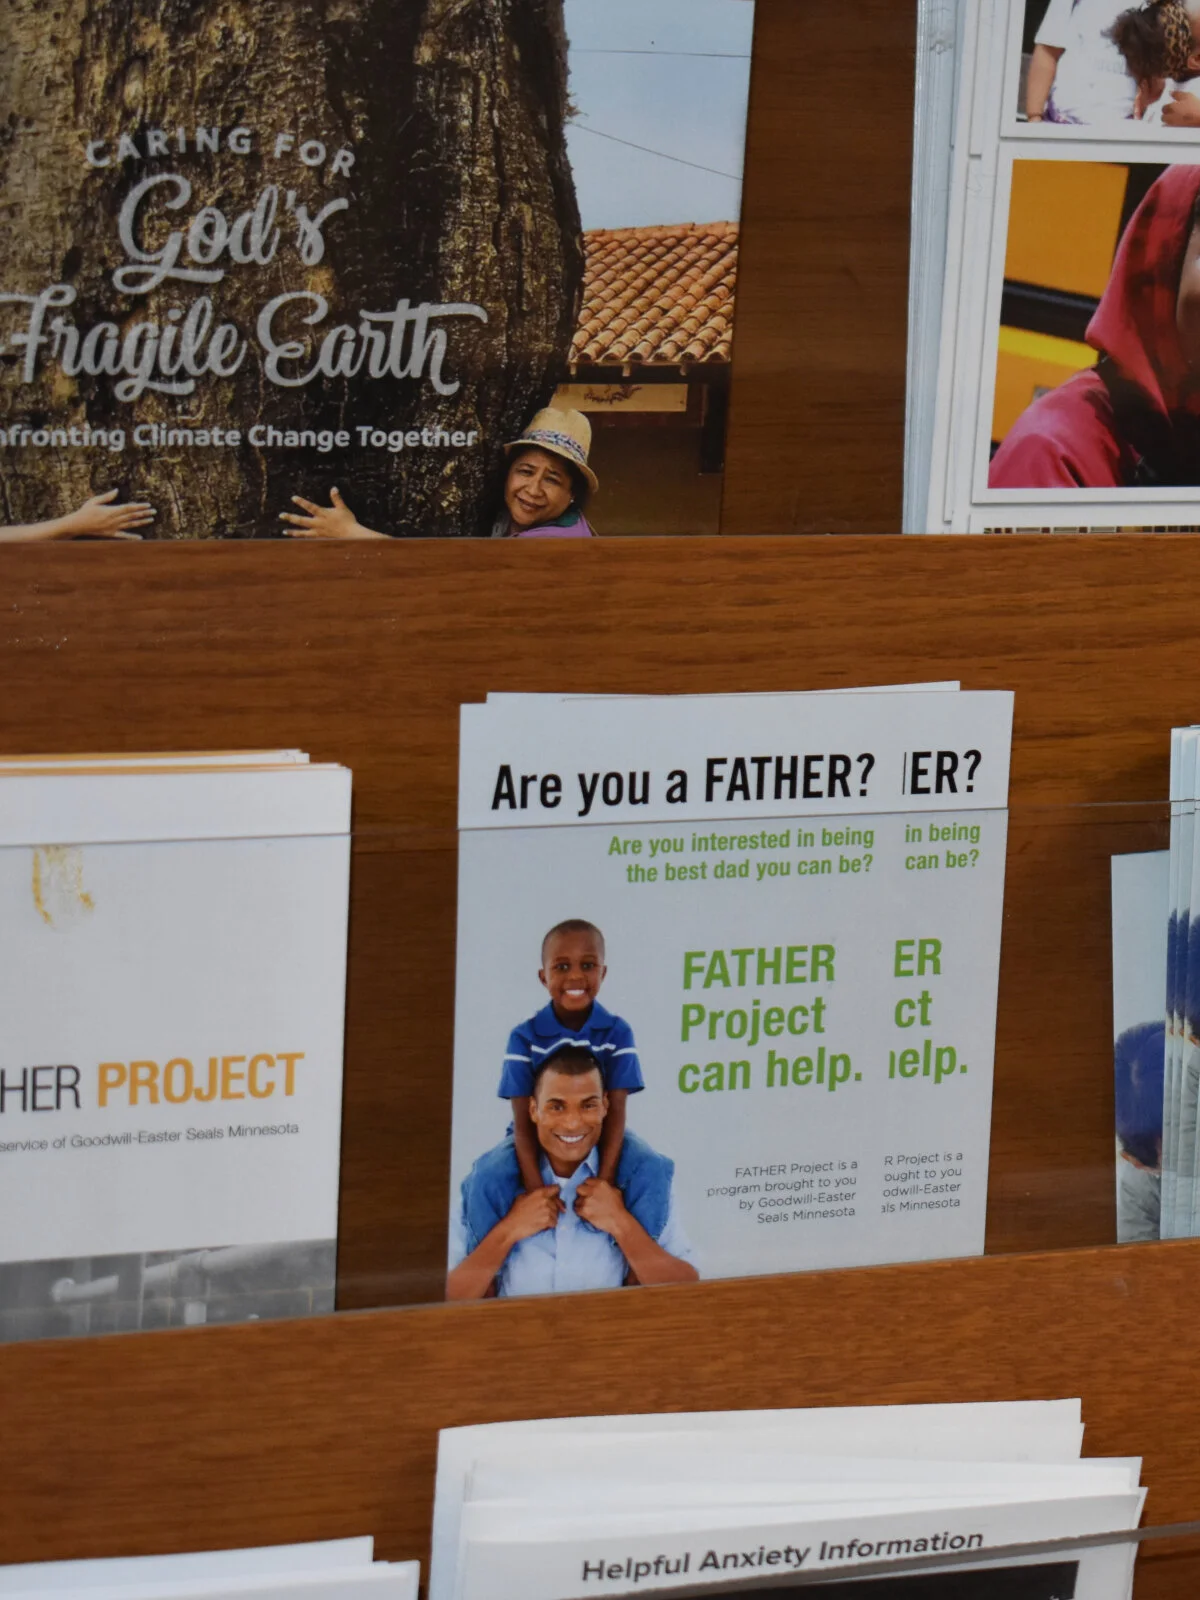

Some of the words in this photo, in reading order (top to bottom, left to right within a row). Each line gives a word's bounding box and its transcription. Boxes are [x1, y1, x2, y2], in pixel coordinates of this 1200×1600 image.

[87, 127, 253, 168] CARING
[275, 133, 356, 177] FOR
[112, 172, 349, 294] God's
[0, 283, 247, 402] Fragile
[256, 290, 489, 396] Earth
[133, 423, 242, 447] Climate
[248, 424, 350, 452] Change
[355, 425, 478, 452] Together
[491, 764, 562, 811] Are
[577, 769, 650, 816] you
[665, 769, 688, 803] a
[704, 751, 875, 803] FATHER?
[902, 749, 982, 795] ER?
[608, 835, 642, 855] Are
[649, 837, 684, 858] you
[691, 829, 791, 852] interested
[797, 828, 815, 848] in
[821, 826, 875, 849] being
[905, 824, 922, 843] in
[929, 822, 981, 845] being
[626, 864, 658, 883] the
[665, 860, 708, 880] best
[713, 859, 750, 878] dad
[756, 859, 791, 881] you
[797, 858, 832, 875] can
[838, 854, 874, 873] be?
[905, 852, 939, 870] can
[945, 849, 980, 868] be?
[682, 943, 836, 990] FATHER
[894, 938, 942, 978] ER
[681, 996, 826, 1047] Project
[894, 990, 933, 1028] ct
[0, 1064, 81, 1113] HER
[98, 1052, 305, 1108] PROJECT
[677, 1058, 751, 1093] can
[766, 1047, 862, 1092] help.
[0, 1139, 48, 1152] service
[52, 1135, 67, 1149] of
[71, 1129, 181, 1149] Goodwill-Easter
[186, 1126, 225, 1141] Seals
[228, 1121, 300, 1138] Minnesota
[736, 1165, 787, 1179] FATHER
[790, 1161, 833, 1174] Project
[837, 1159, 848, 1171] is
[850, 1160, 858, 1170] a
[884, 1155, 893, 1166] R
[897, 1152, 939, 1165] Project
[943, 1151, 953, 1162] is
[956, 1152, 963, 1161] a
[707, 1184, 761, 1198] program
[764, 1178, 814, 1192] brought
[818, 1177, 831, 1188] to
[835, 1176, 857, 1188] you
[882, 1183, 962, 1197] odwill-Easter
[884, 1169, 921, 1182] ought
[924, 1169, 937, 1179] to
[940, 1168, 962, 1179] you
[739, 1199, 753, 1211] by
[758, 1191, 857, 1208] Goodwill-Easter
[757, 1211, 789, 1224] Seals
[793, 1206, 856, 1221] Minnesota
[899, 1198, 961, 1211] Minnesota
[582, 1552, 690, 1583] Helpful
[699, 1545, 811, 1571] Anxiety
[818, 1531, 984, 1562] Information
